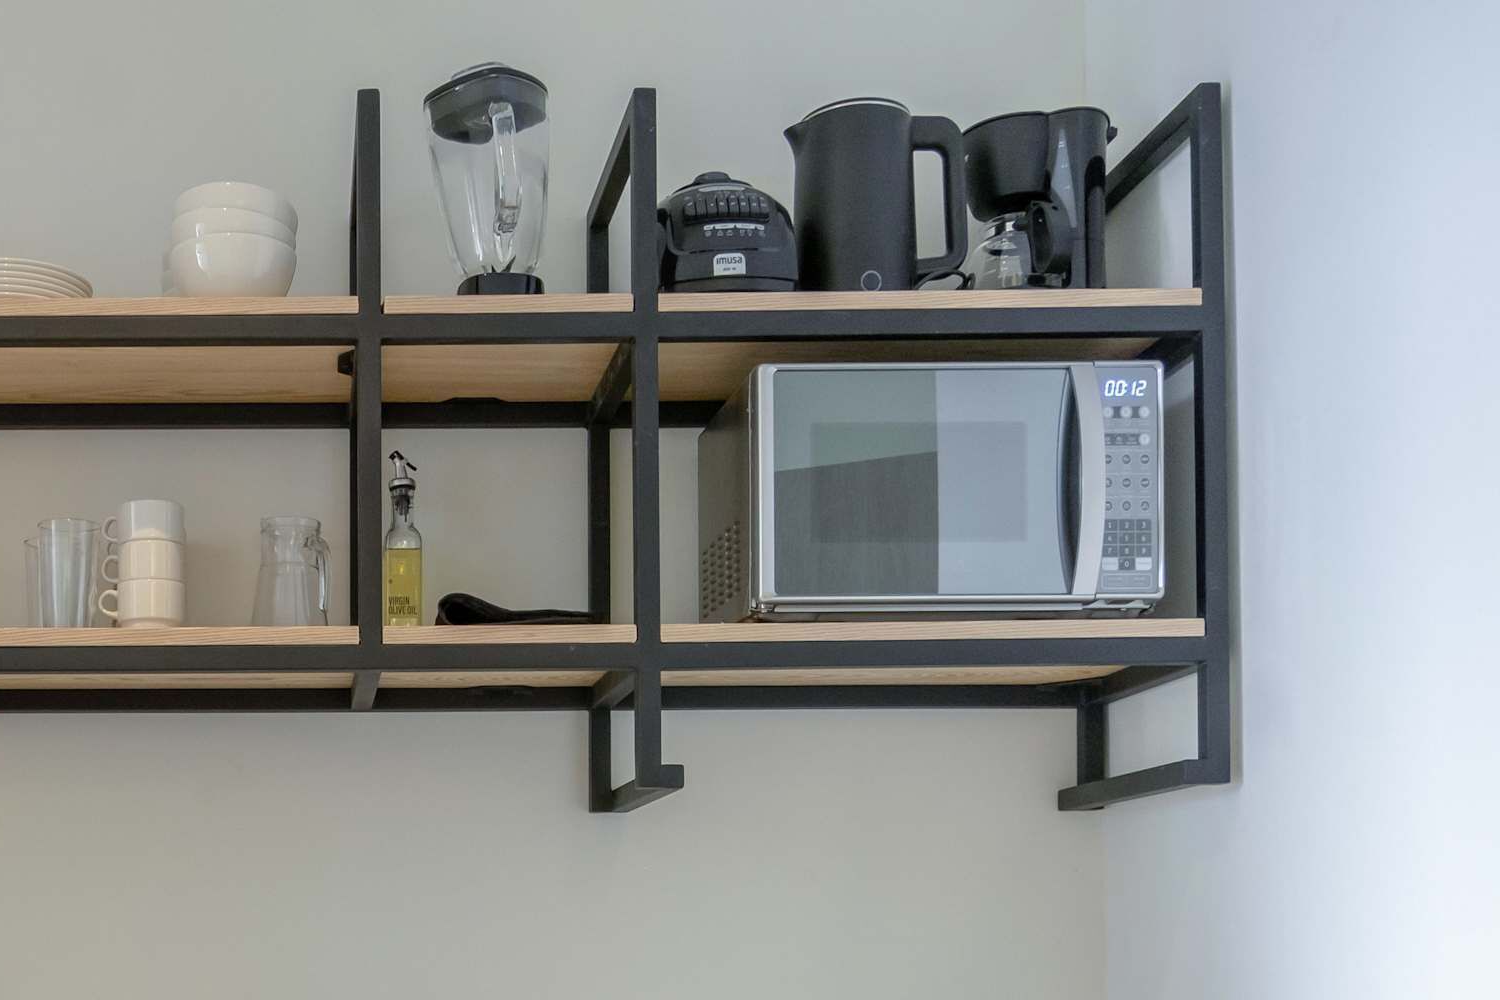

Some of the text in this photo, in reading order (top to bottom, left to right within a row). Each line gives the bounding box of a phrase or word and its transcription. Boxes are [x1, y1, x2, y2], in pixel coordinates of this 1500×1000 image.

[1104, 380, 1147, 396] 00:12
[388, 596, 410, 605] VIRGIN
[388, 606, 418, 616] OLIVE OIL
